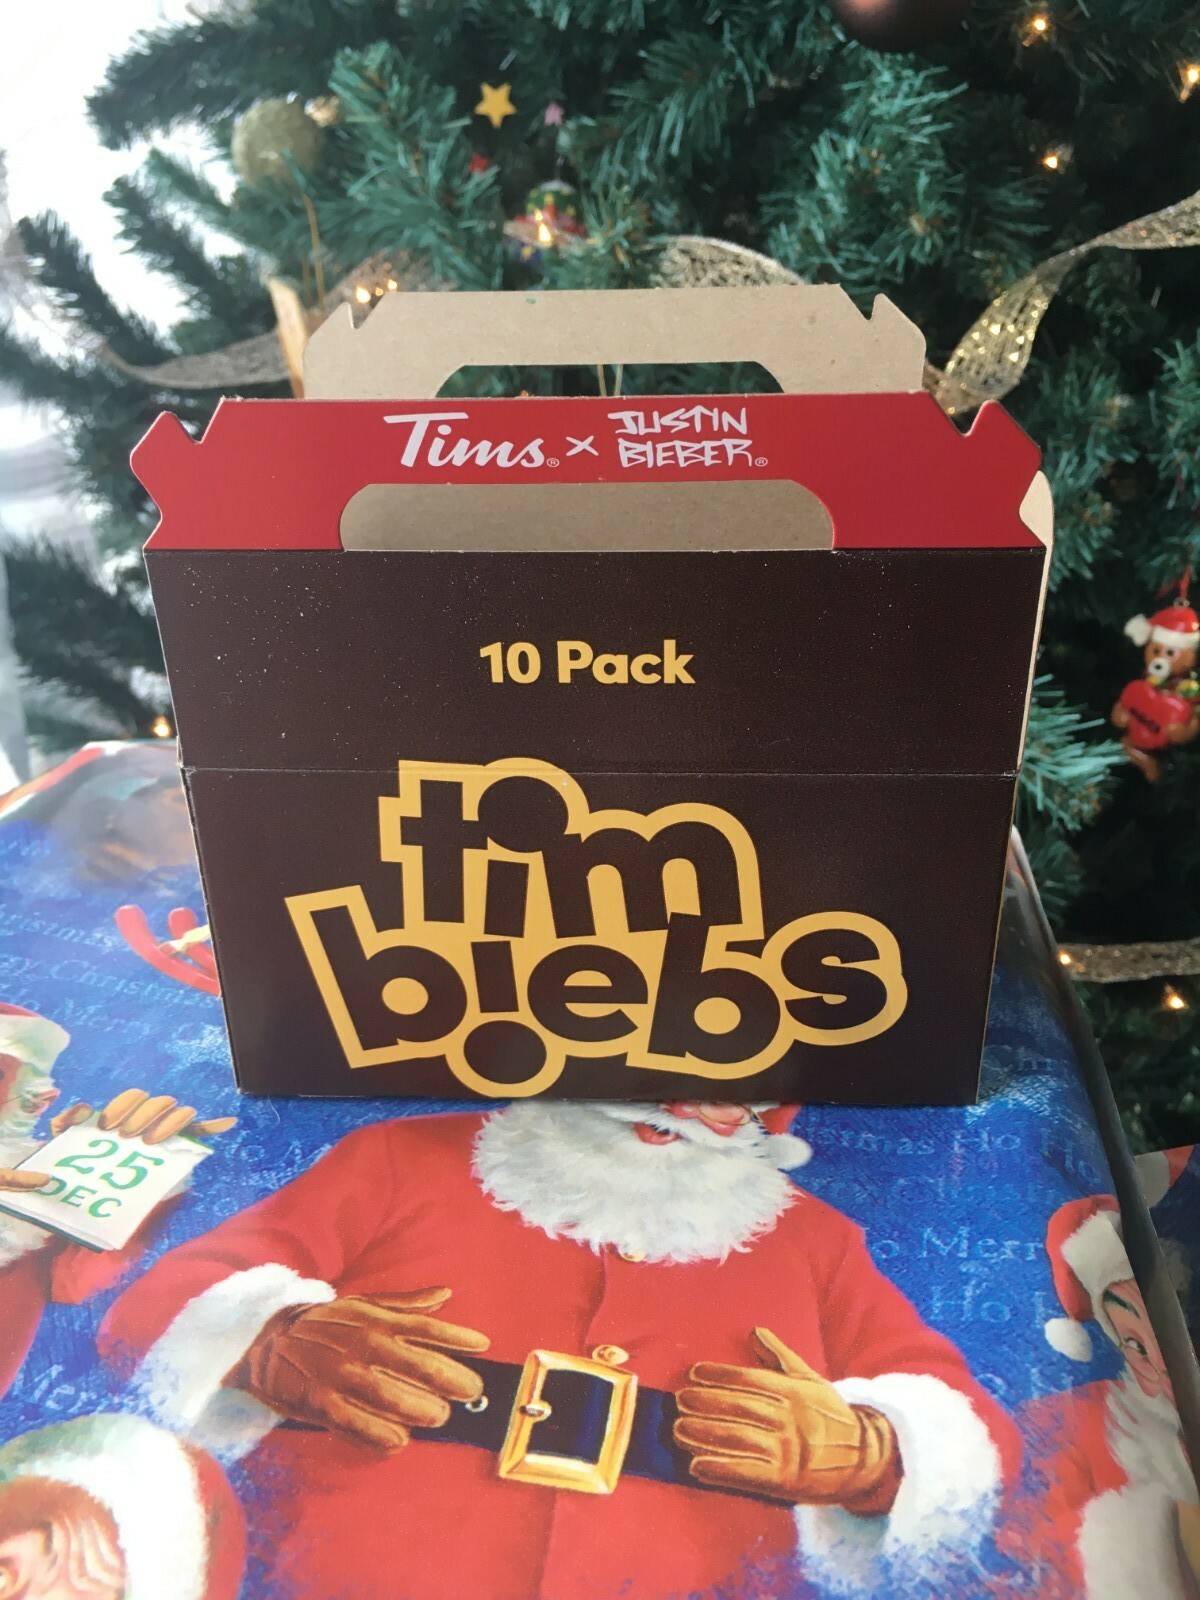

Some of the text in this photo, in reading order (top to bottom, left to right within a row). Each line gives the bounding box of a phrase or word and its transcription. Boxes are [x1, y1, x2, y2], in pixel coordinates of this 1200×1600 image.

[607, 404, 747, 435] JUSTIN
[479, 639, 696, 684] 10 Pack
[380, 758, 765, 940] tim
[54, 1138, 165, 1190] 25
[34, 1176, 123, 1218] DEC
